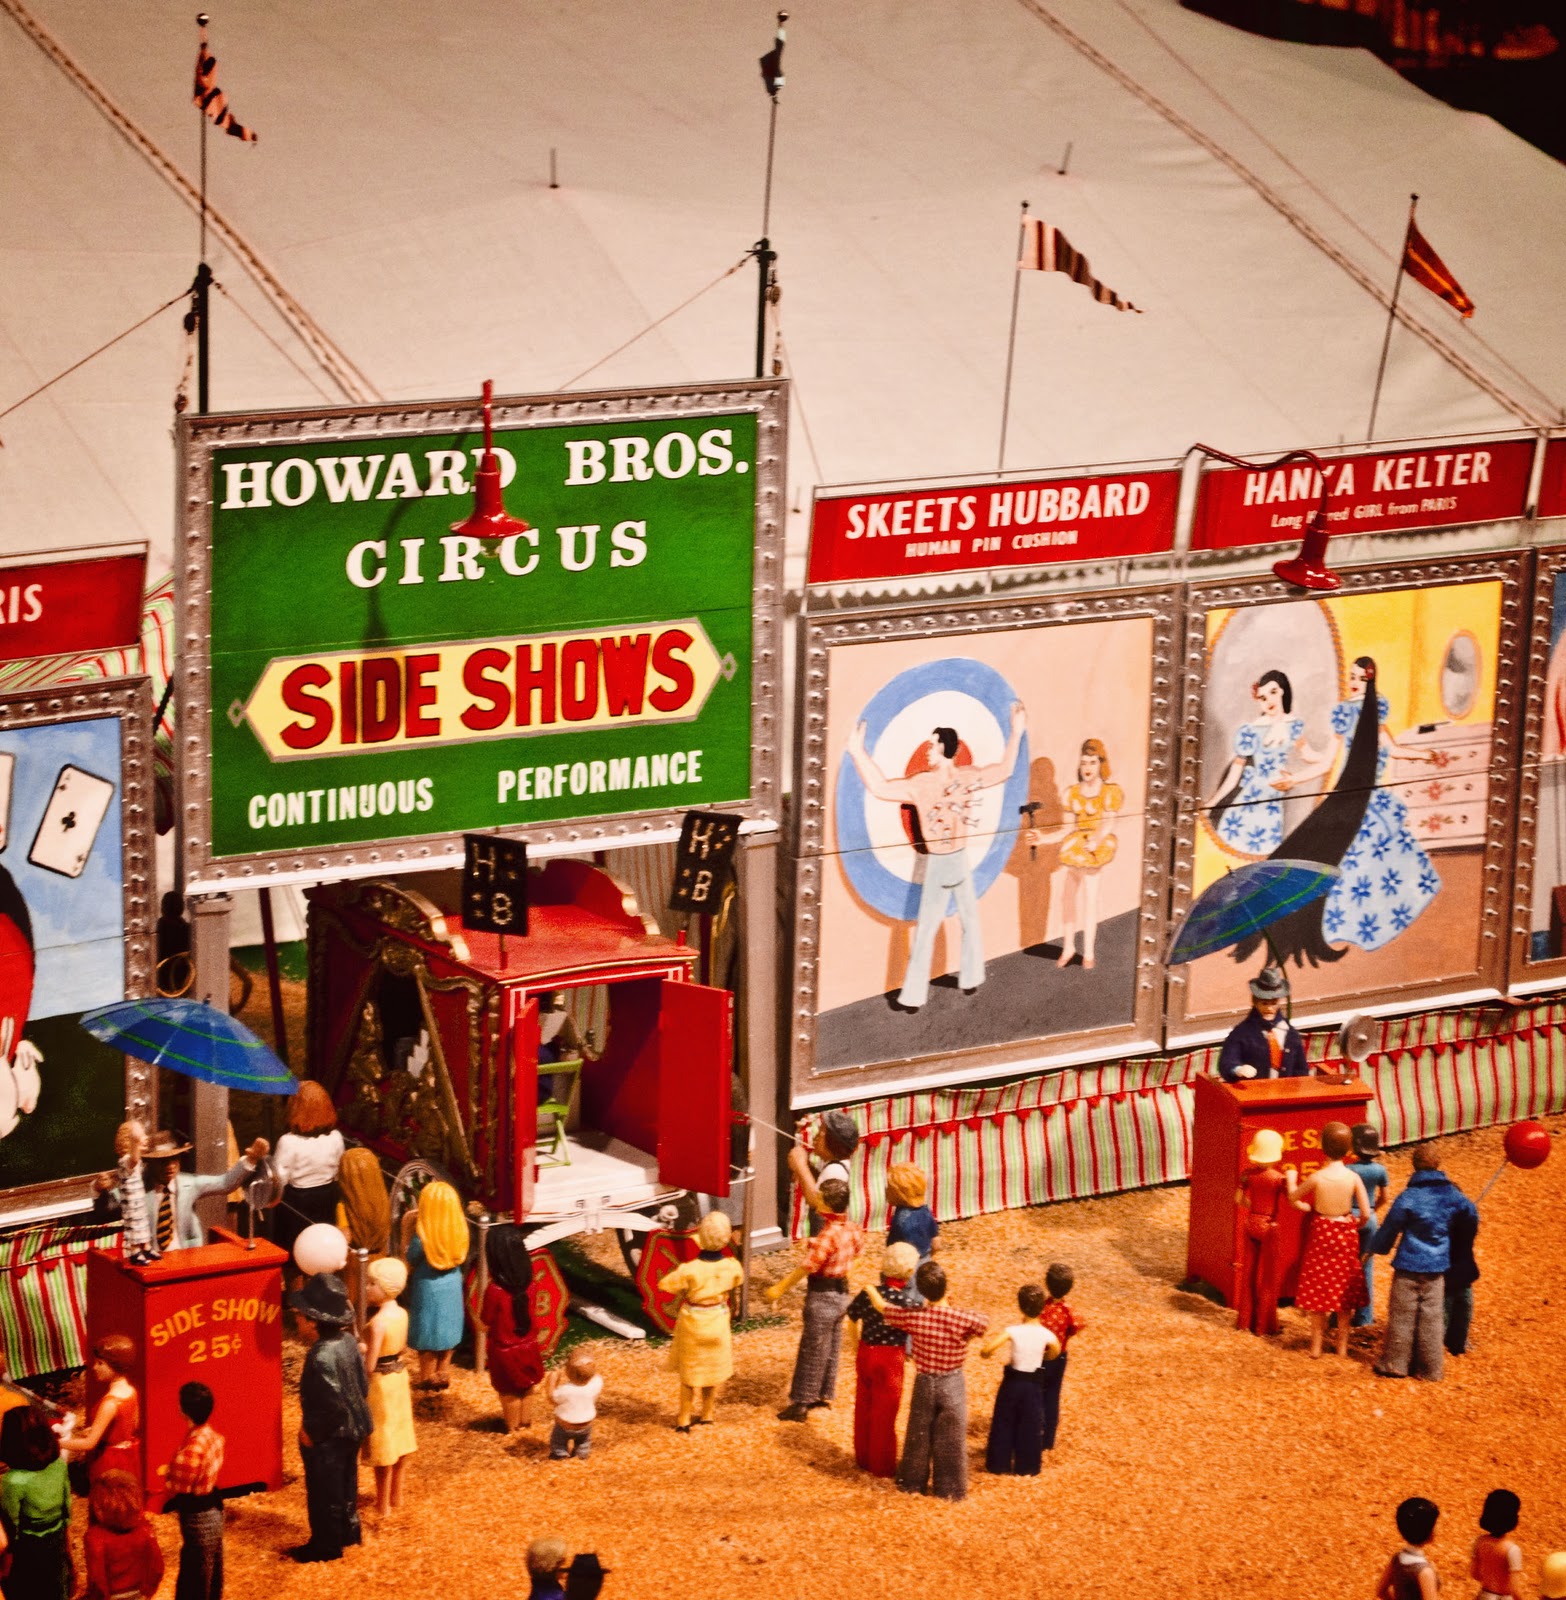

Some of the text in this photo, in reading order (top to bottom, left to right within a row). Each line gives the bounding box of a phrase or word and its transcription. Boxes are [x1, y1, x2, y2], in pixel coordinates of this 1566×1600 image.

[220, 429, 750, 510] HOWARD BROS.
[1373, 451, 1492, 492] KELTER
[845, 482, 1150, 540] SKEETS HUBBARD
[1271, 514, 1303, 529] Long
[1353, 504, 1384, 518] GIRL
[1387, 502, 1419, 515] from
[1420, 496, 1458, 512] PARIS
[345, 520, 648, 589] CIRCUS
[905, 530, 1078, 557] HUMAN PIN CUSHION
[280, 629, 695, 751] SIDE SHOWS
[248, 750, 703, 829] CONTINUOUS PERFORMANCE
[150, 1298, 281, 1348] SIDE SHOW
[188, 1334, 242, 1363] 25¢
